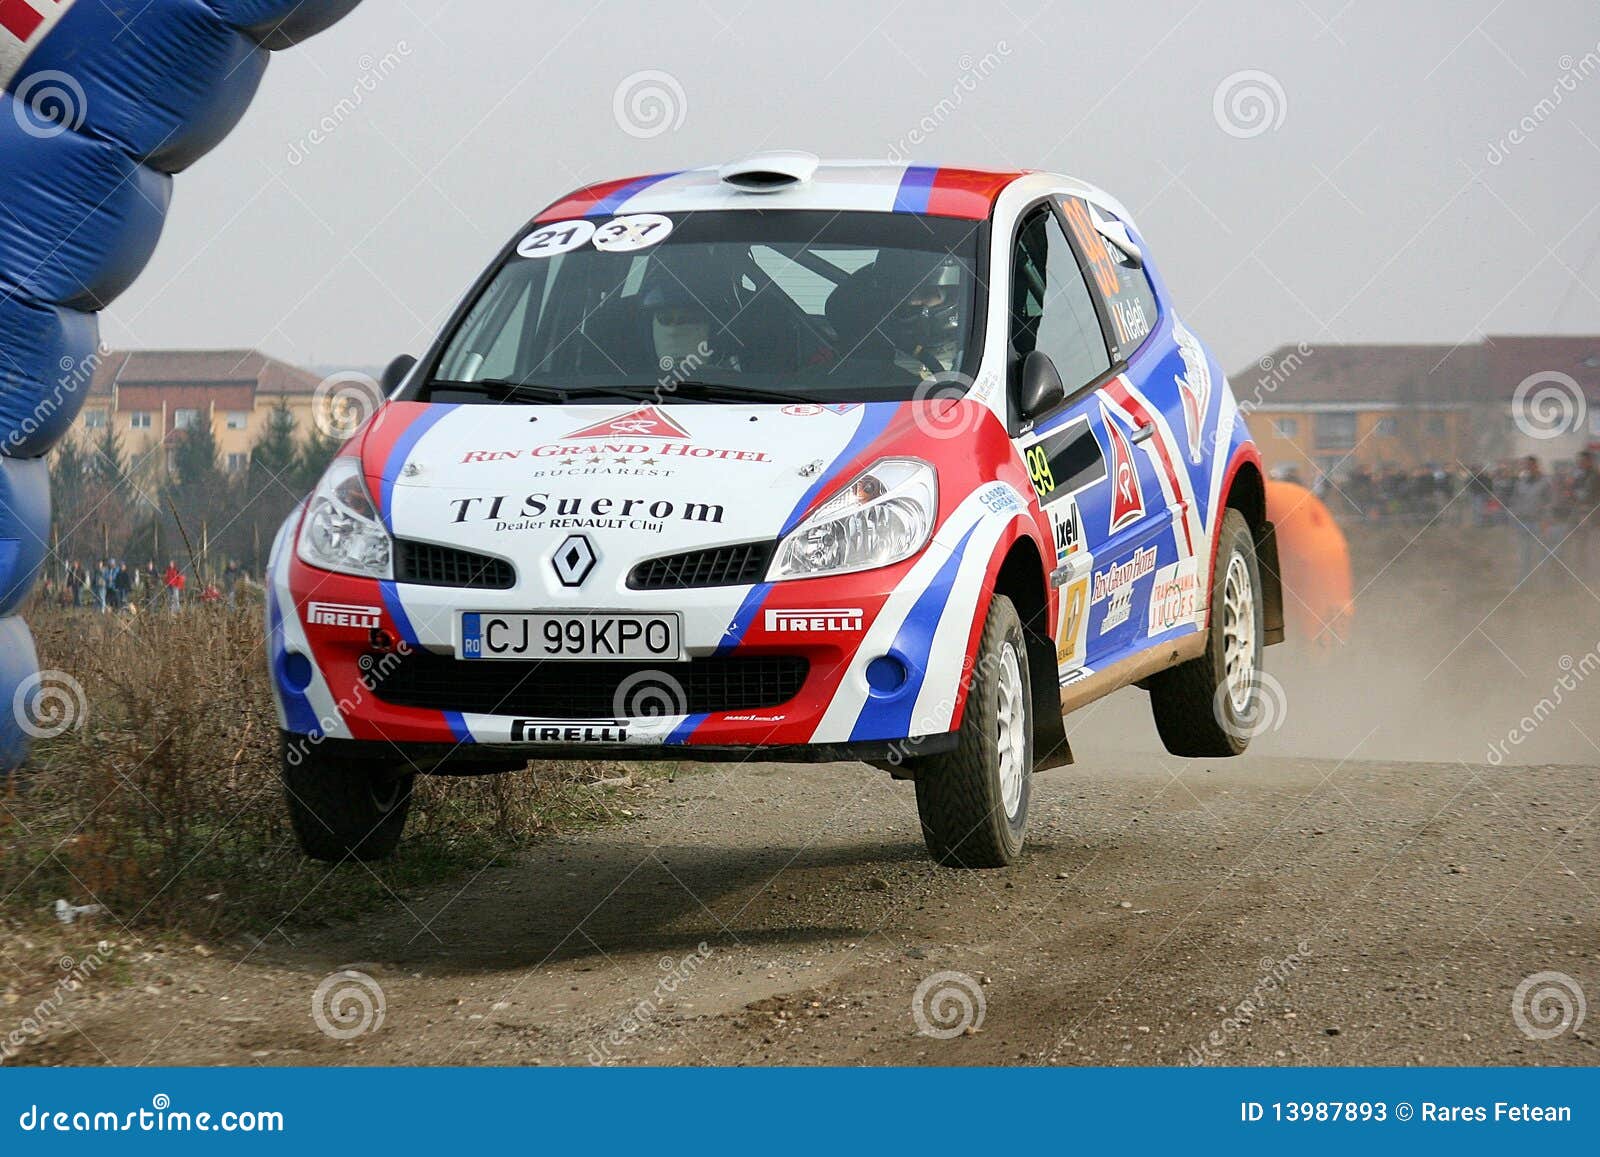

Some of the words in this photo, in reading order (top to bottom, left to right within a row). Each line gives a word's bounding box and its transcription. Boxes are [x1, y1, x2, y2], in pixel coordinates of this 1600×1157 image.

[524, 226, 579, 250] 21
[458, 449, 523, 464] RIN
[531, 443, 650, 458] GRAND
[652, 443, 773, 463] HOTEL
[533, 467, 676, 477] BUCHAREST
[1026, 445, 1055, 496] 99
[450, 495, 509, 524] TI
[520, 493, 725, 524] Suerom
[495, 518, 547, 532] Dealer
[549, 518, 627, 529] RENAULT
[630, 519, 665, 534] Cluj
[1054, 502, 1079, 549] ixell
[1108, 563, 1133, 592] GRAND
[1134, 549, 1155, 578] HOTEL
[307, 601, 382, 628] PIRELLI
[764, 608, 864, 632] PIRELLI
[465, 639, 480, 653] RO
[486, 619, 529, 653] CJ
[511, 719, 631, 741] PIRELLI
